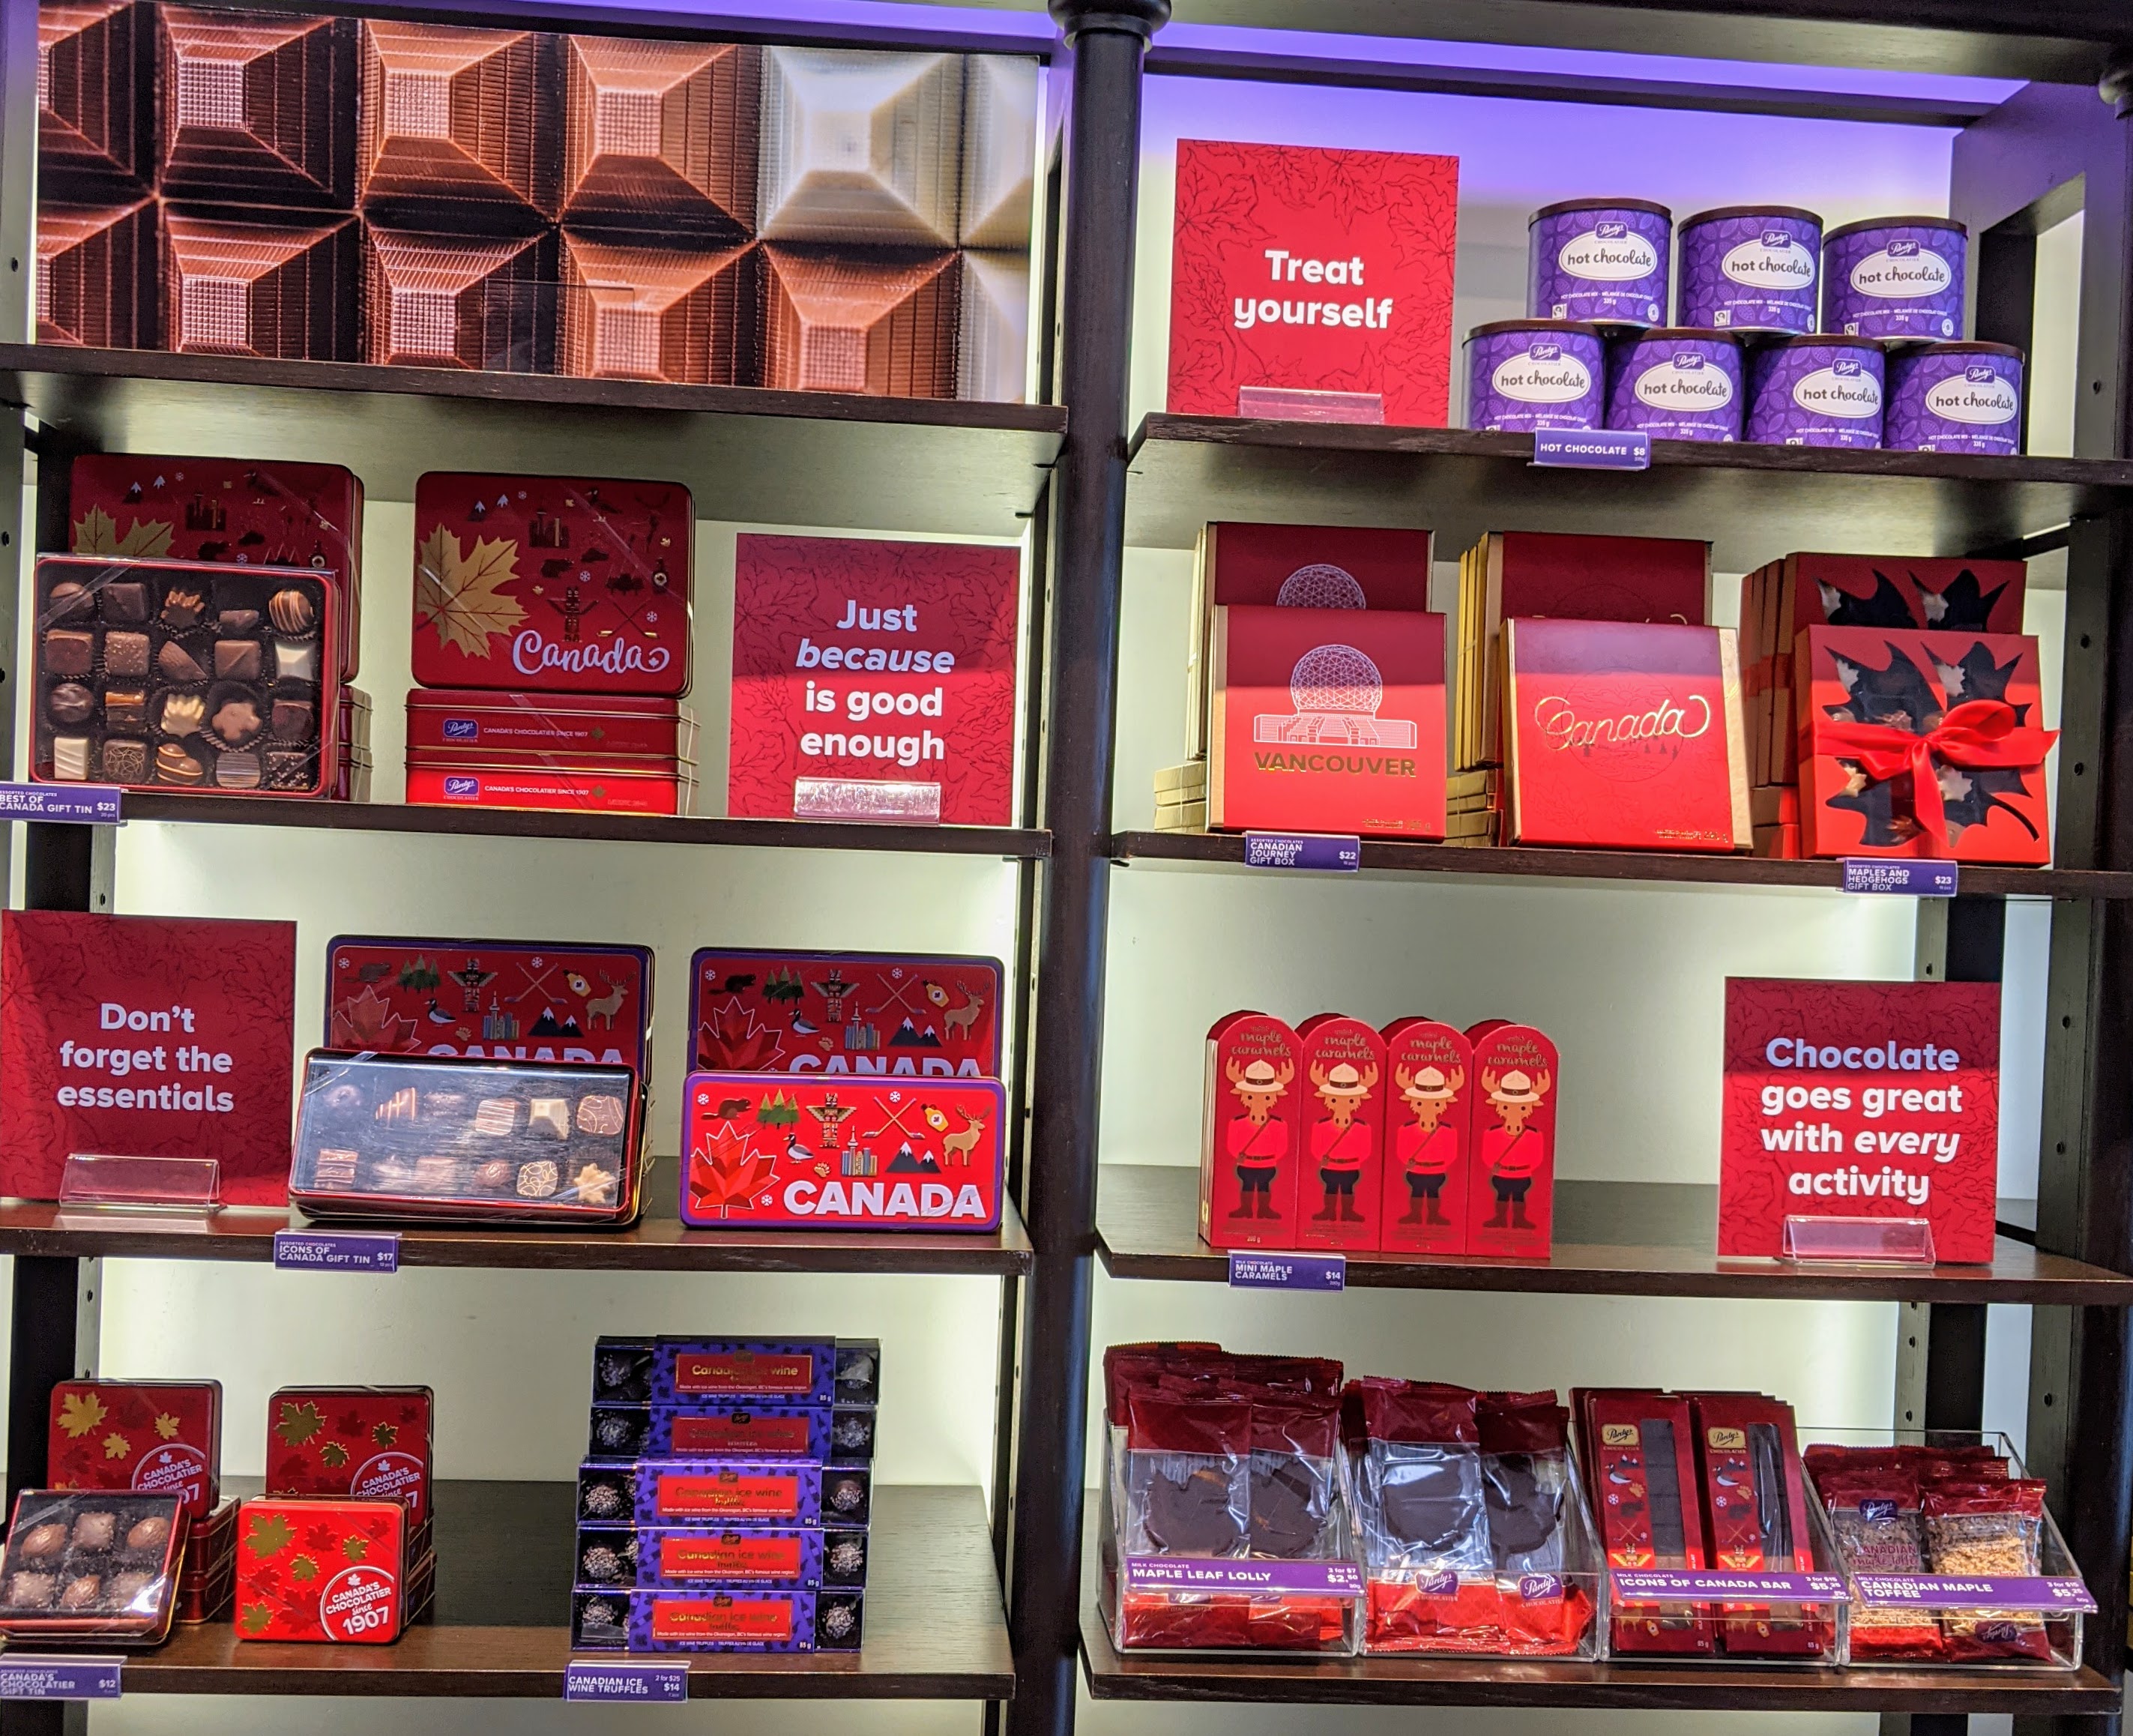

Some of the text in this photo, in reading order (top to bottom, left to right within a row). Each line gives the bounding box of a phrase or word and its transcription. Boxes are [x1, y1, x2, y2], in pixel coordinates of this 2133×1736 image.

[1567, 247, 1652, 267] hot chocolate
[1265, 249, 1364, 285] Treat
[1731, 256, 1811, 277] hot chocolate
[1859, 264, 1946, 285] hot chocolate
[1234, 297, 1394, 329] yourself
[1500, 370, 1585, 389] hot chocolate
[1644, 378, 1727, 397] hot chocolate
[1802, 385, 1878, 405] hot chocolate
[1935, 391, 2014, 411] hot chocolate
[1540, 443, 1646, 456] HOT CHOCOLATE $8
[836, 600, 917, 632] Just
[513, 630, 670, 675] Canada
[795, 638, 956, 674] because
[805, 681, 943, 722] is good
[449, 720, 474, 736] Purdys
[1534, 694, 1710, 751] Canada
[515, 728, 555, 736] CHOCOLATIER
[800, 729, 944, 767] enough
[1253, 751, 1417, 779] VANCOUVER
[449, 778, 475, 795] Purdys
[485, 785, 515, 793] CANADA'S
[516, 786, 556, 795] CHOCOLATIER
[0, 795, 44, 804] BEST OF
[0, 801, 116, 814] CANADA GIFT TIN $23
[1250, 842, 1303, 852] CANADIAN
[1250, 849, 1357, 860] JOURNEY $22
[1249, 857, 1295, 866] GIFT BOX
[1848, 868, 1910, 878] MAPLES AND
[1848, 875, 1952, 885] HEDGEHOGS $23
[1847, 882, 1892, 891] GIFT BOX
[100, 1002, 195, 1033] Don't
[1240, 1032, 1282, 1047] maple
[1324, 1034, 1366, 1050] maple
[1410, 1037, 1452, 1052] maple
[1231, 1044, 1291, 1058] caramels
[1315, 1047, 1375, 1061] caramels
[1496, 1040, 1539, 1055] maple
[1765, 1037, 1960, 1072] Chocolate
[59, 1040, 233, 1076] forget the
[1401, 1051, 1461, 1064] caramels
[1487, 1054, 1548, 1068] caramels
[57, 1082, 234, 1113] essentials
[1761, 1085, 1962, 1118] goes great
[1761, 1121, 1961, 1163] with every
[1788, 1165, 1929, 1205] activity
[783, 1180, 986, 1219] CANADA
[279, 1245, 331, 1255] ICONS OF
[279, 1251, 393, 1264] CANADA GIFT TIN $17
[1235, 1264, 1293, 1274] MINI MAPLE
[1235, 1270, 1341, 1281] CARAMELS $14
[1607, 1428, 1634, 1443] Purdys
[1713, 1432, 1740, 1446] Purdys
[137, 1464, 203, 1490] CHOCOLATIER
[143, 1459, 192, 1481] CANADA'S
[361, 1466, 409, 1489] CANADA'S
[1132, 1568, 1272, 1582] MAPLE LEAF LOLLY
[1619, 1578, 1792, 1590] ICONS OF CANADA BAR
[1861, 1580, 1994, 1593] CANADIAN MAPLE
[331, 1581, 381, 1604] CANADA'S
[1864, 1589, 1922, 1599] TOFFEE
[2052, 1588, 2084, 1598] $5.25
[325, 1586, 392, 1615] CHOCOLATIER
[352, 1602, 373, 1615] since
[343, 1606, 390, 1636] 1907
[0, 1672, 55, 1681] CANADA'S
[0, 1678, 115, 1689] CHOCOLATIER $12
[569, 1676, 643, 1687] CANADIAN ICE
[1, 1687, 25, 1696] GIFT
[568, 1683, 680, 1694] WINE TRUFFLES $14
